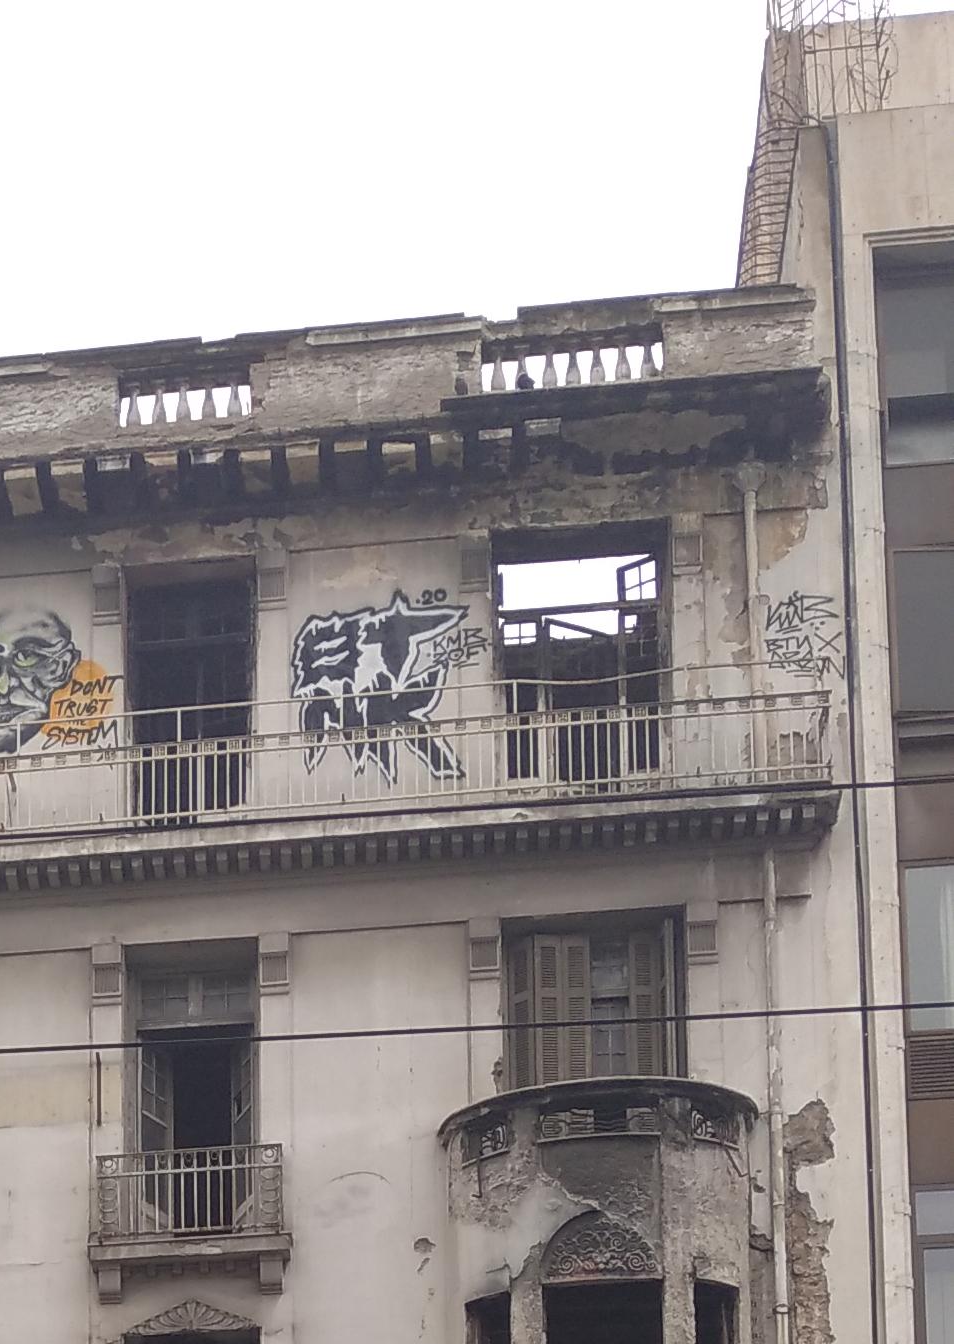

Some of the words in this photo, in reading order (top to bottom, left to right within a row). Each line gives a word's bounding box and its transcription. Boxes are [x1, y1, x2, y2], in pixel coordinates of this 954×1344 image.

[70, 675, 125, 697] DONT
[54, 698, 113, 718] TRUST
[41, 720, 119, 750] SYSTEM
